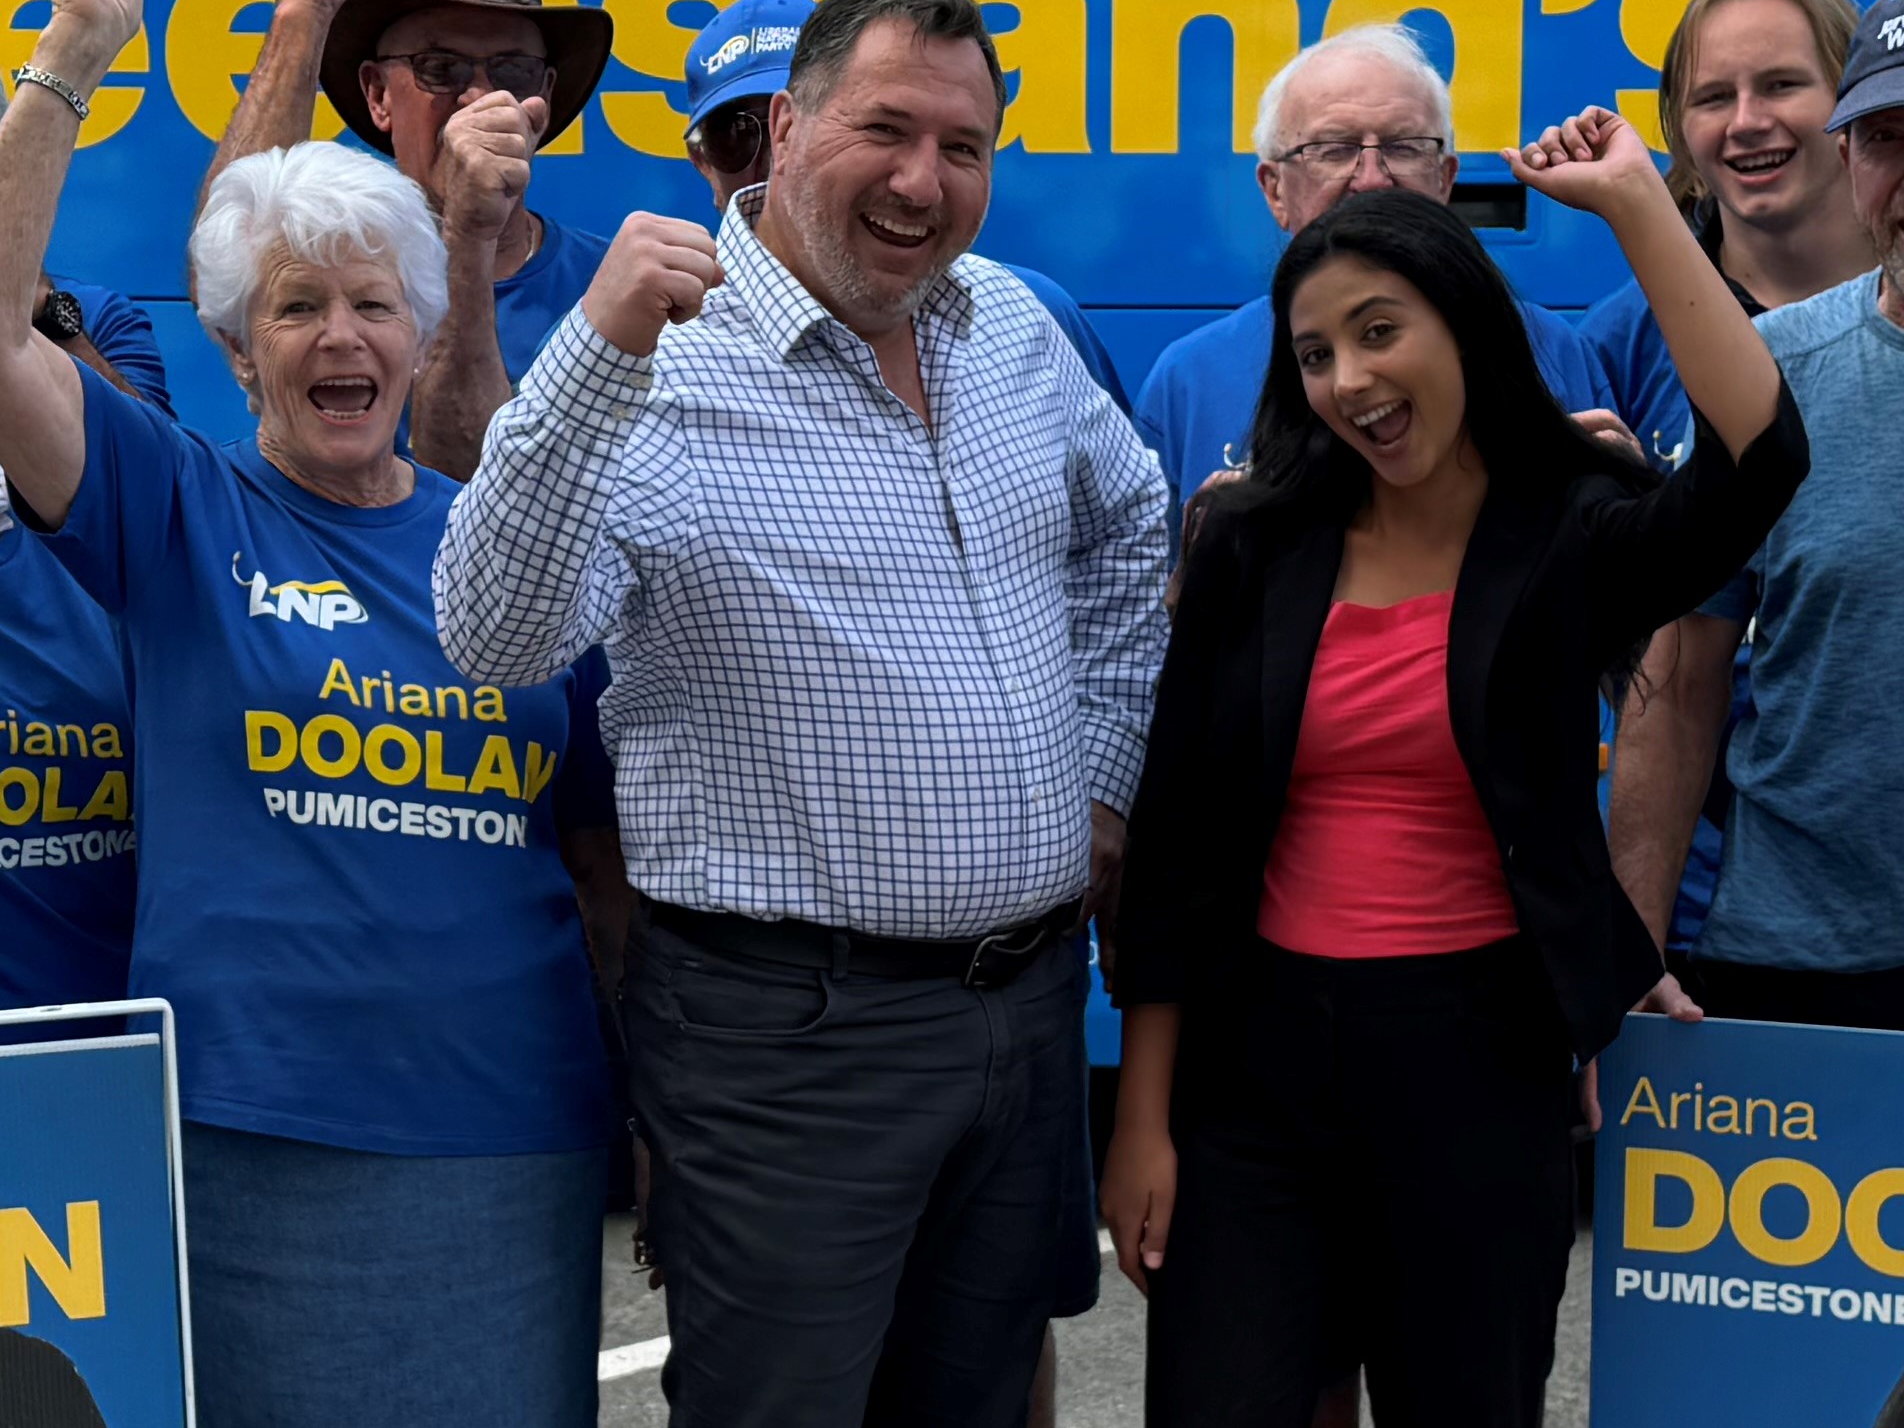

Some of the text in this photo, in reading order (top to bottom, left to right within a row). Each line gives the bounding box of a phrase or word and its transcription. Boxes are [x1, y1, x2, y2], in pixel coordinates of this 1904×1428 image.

[248, 570, 363, 632] LNP
[318, 657, 508, 723] Ariana
[244, 709, 558, 805] DOOLAN
[1618, 1075, 1819, 1143] Ariana
